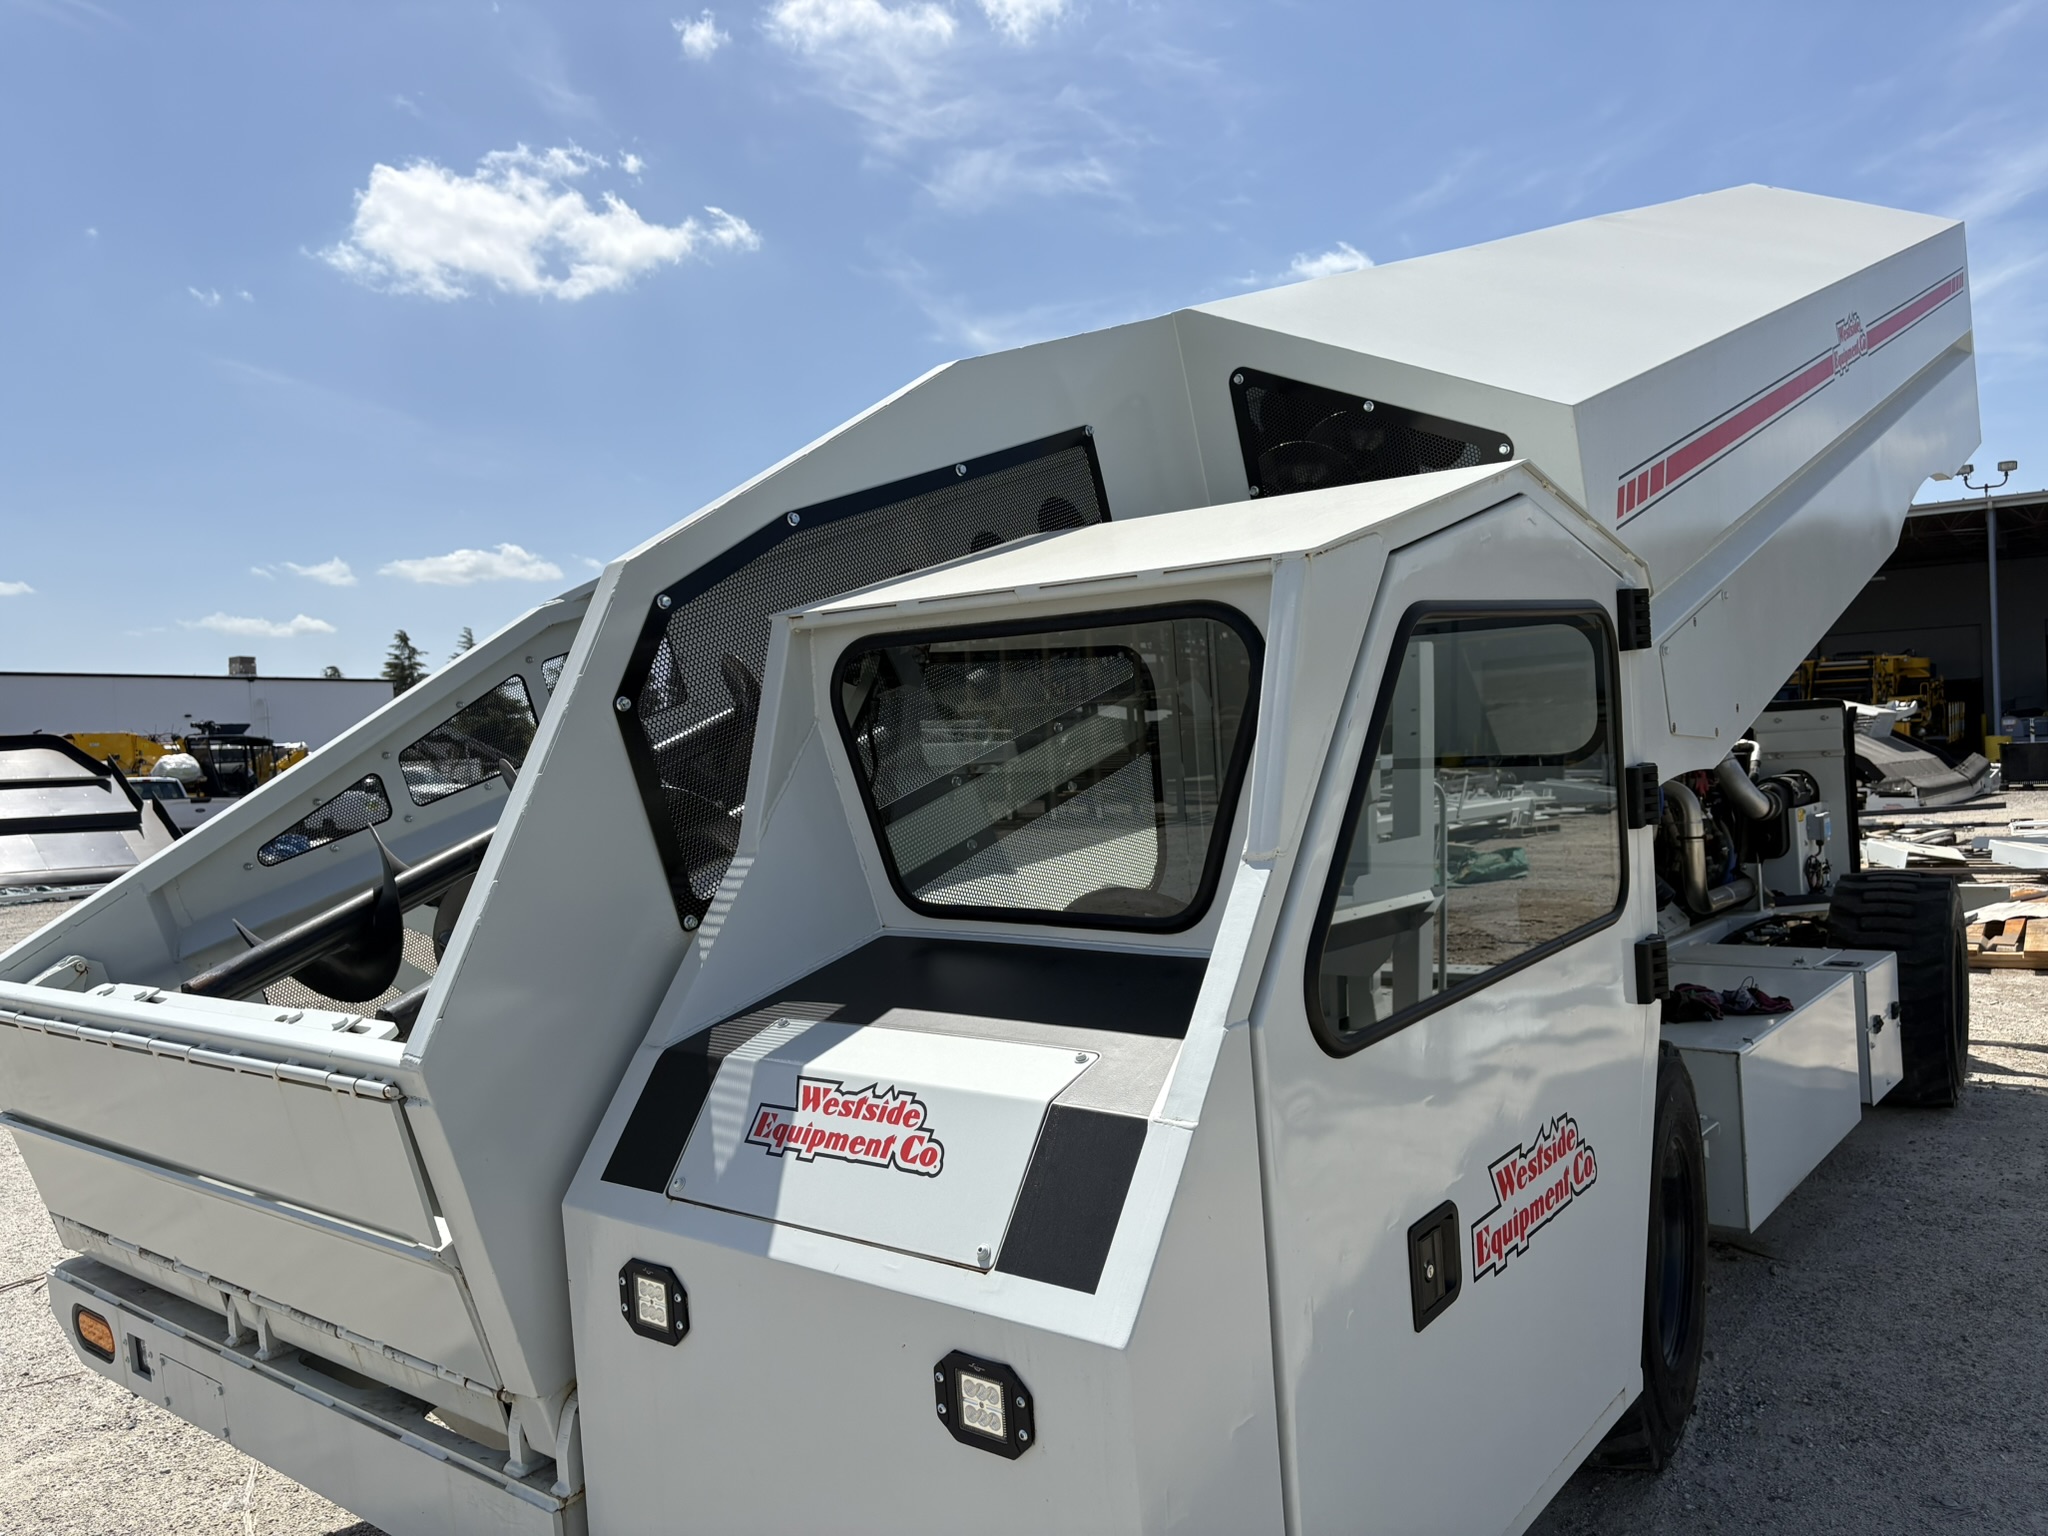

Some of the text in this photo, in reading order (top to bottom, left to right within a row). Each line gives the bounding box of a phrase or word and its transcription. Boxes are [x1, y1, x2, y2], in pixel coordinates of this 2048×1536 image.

[753, 1111, 897, 1159] Equipment
[802, 1085, 921, 1128] Westside
[1496, 1125, 1576, 1201] Westside
[1476, 1165, 1570, 1268] Equipment
